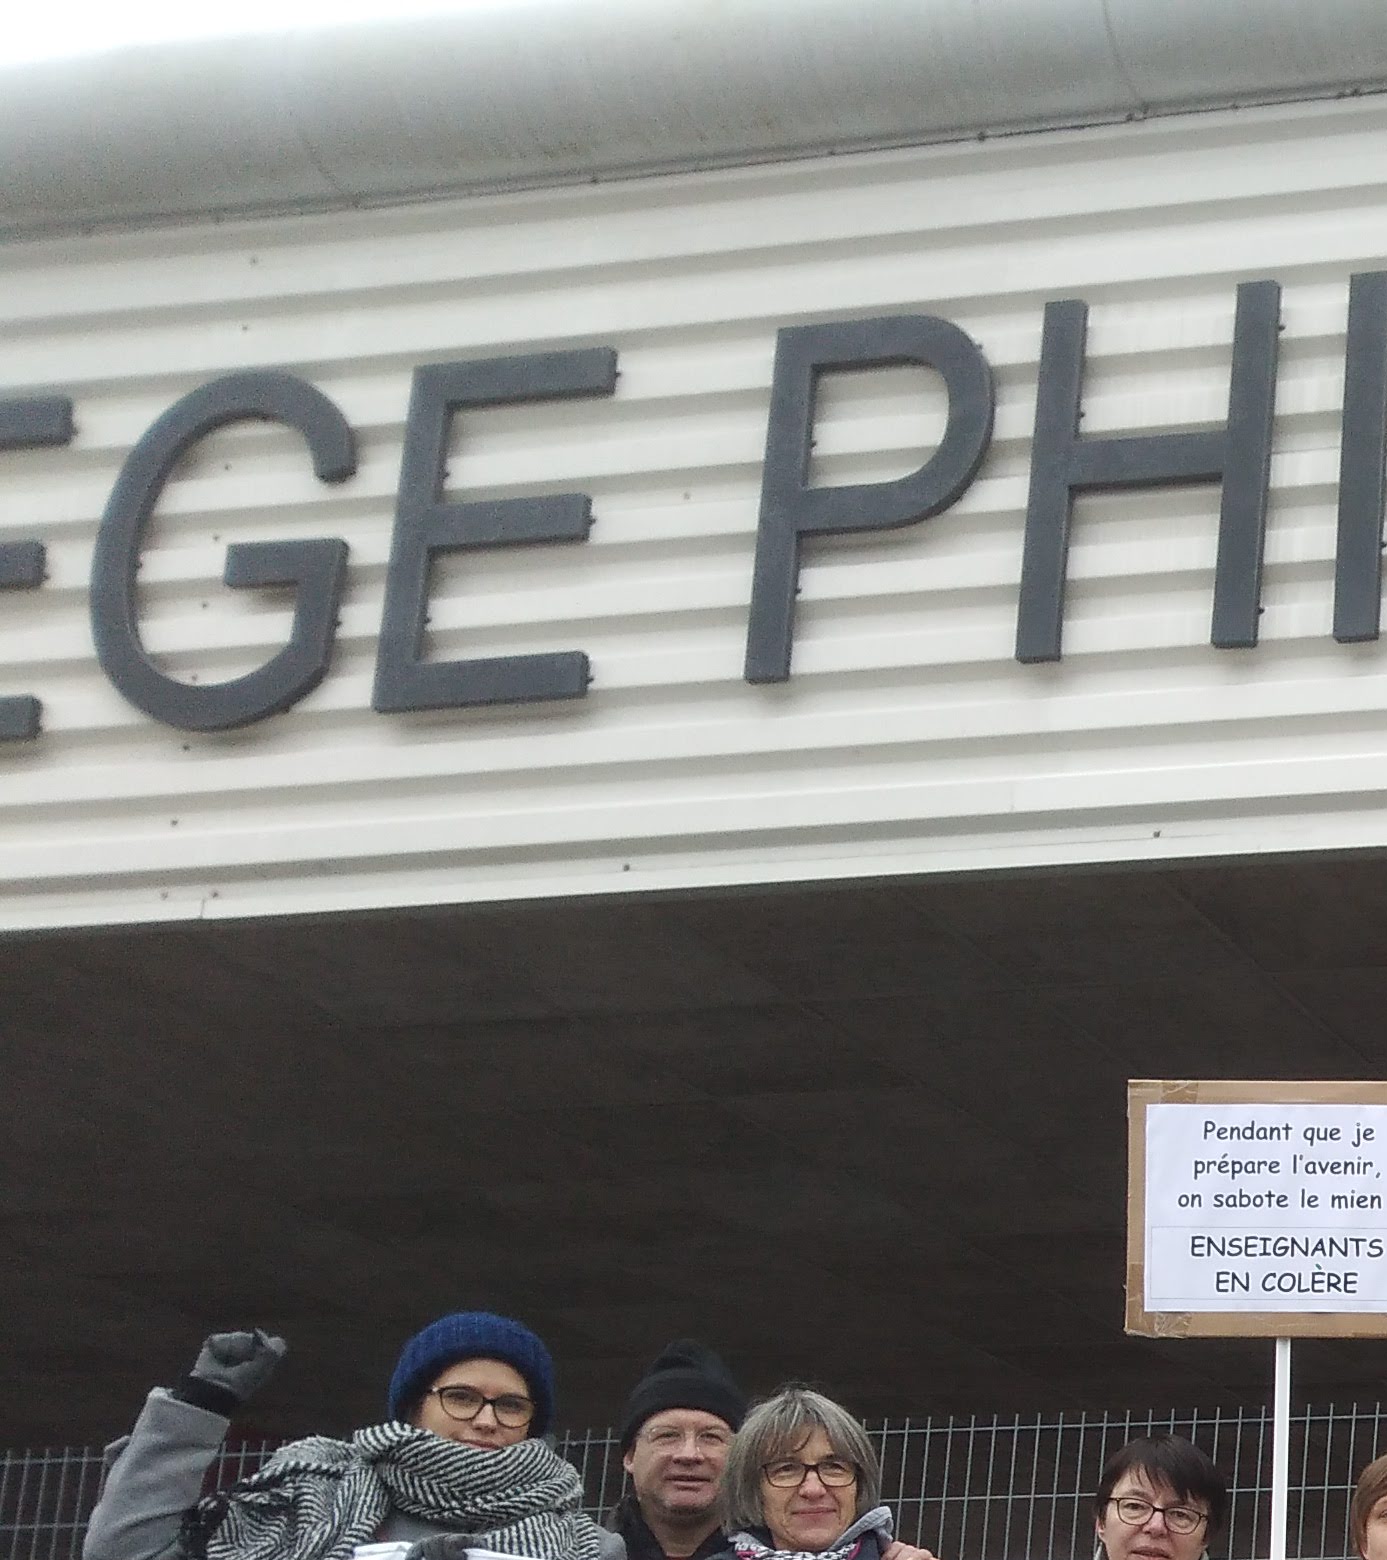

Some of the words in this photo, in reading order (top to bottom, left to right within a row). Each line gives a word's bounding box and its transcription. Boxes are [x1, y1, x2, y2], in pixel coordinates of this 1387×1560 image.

[1202, 1120, 1294, 1142] Pendant
[1302, 1125, 1343, 1151] que
[1350, 1122, 1376, 1148] je
[1192, 1153, 1281, 1180] prépare
[1292, 1153, 1382, 1179] l'avenir,
[1177, 1192, 1203, 1209] on
[1212, 1188, 1289, 1209] sabote
[1300, 1188, 1320, 1208] le
[1330, 1188, 1383, 1210] mien
[1189, 1235, 1385, 1259] ENSEIGNANTS
[1214, 1271, 1251, 1294] EN
[1260, 1263, 1360, 1295] COLÈRE
